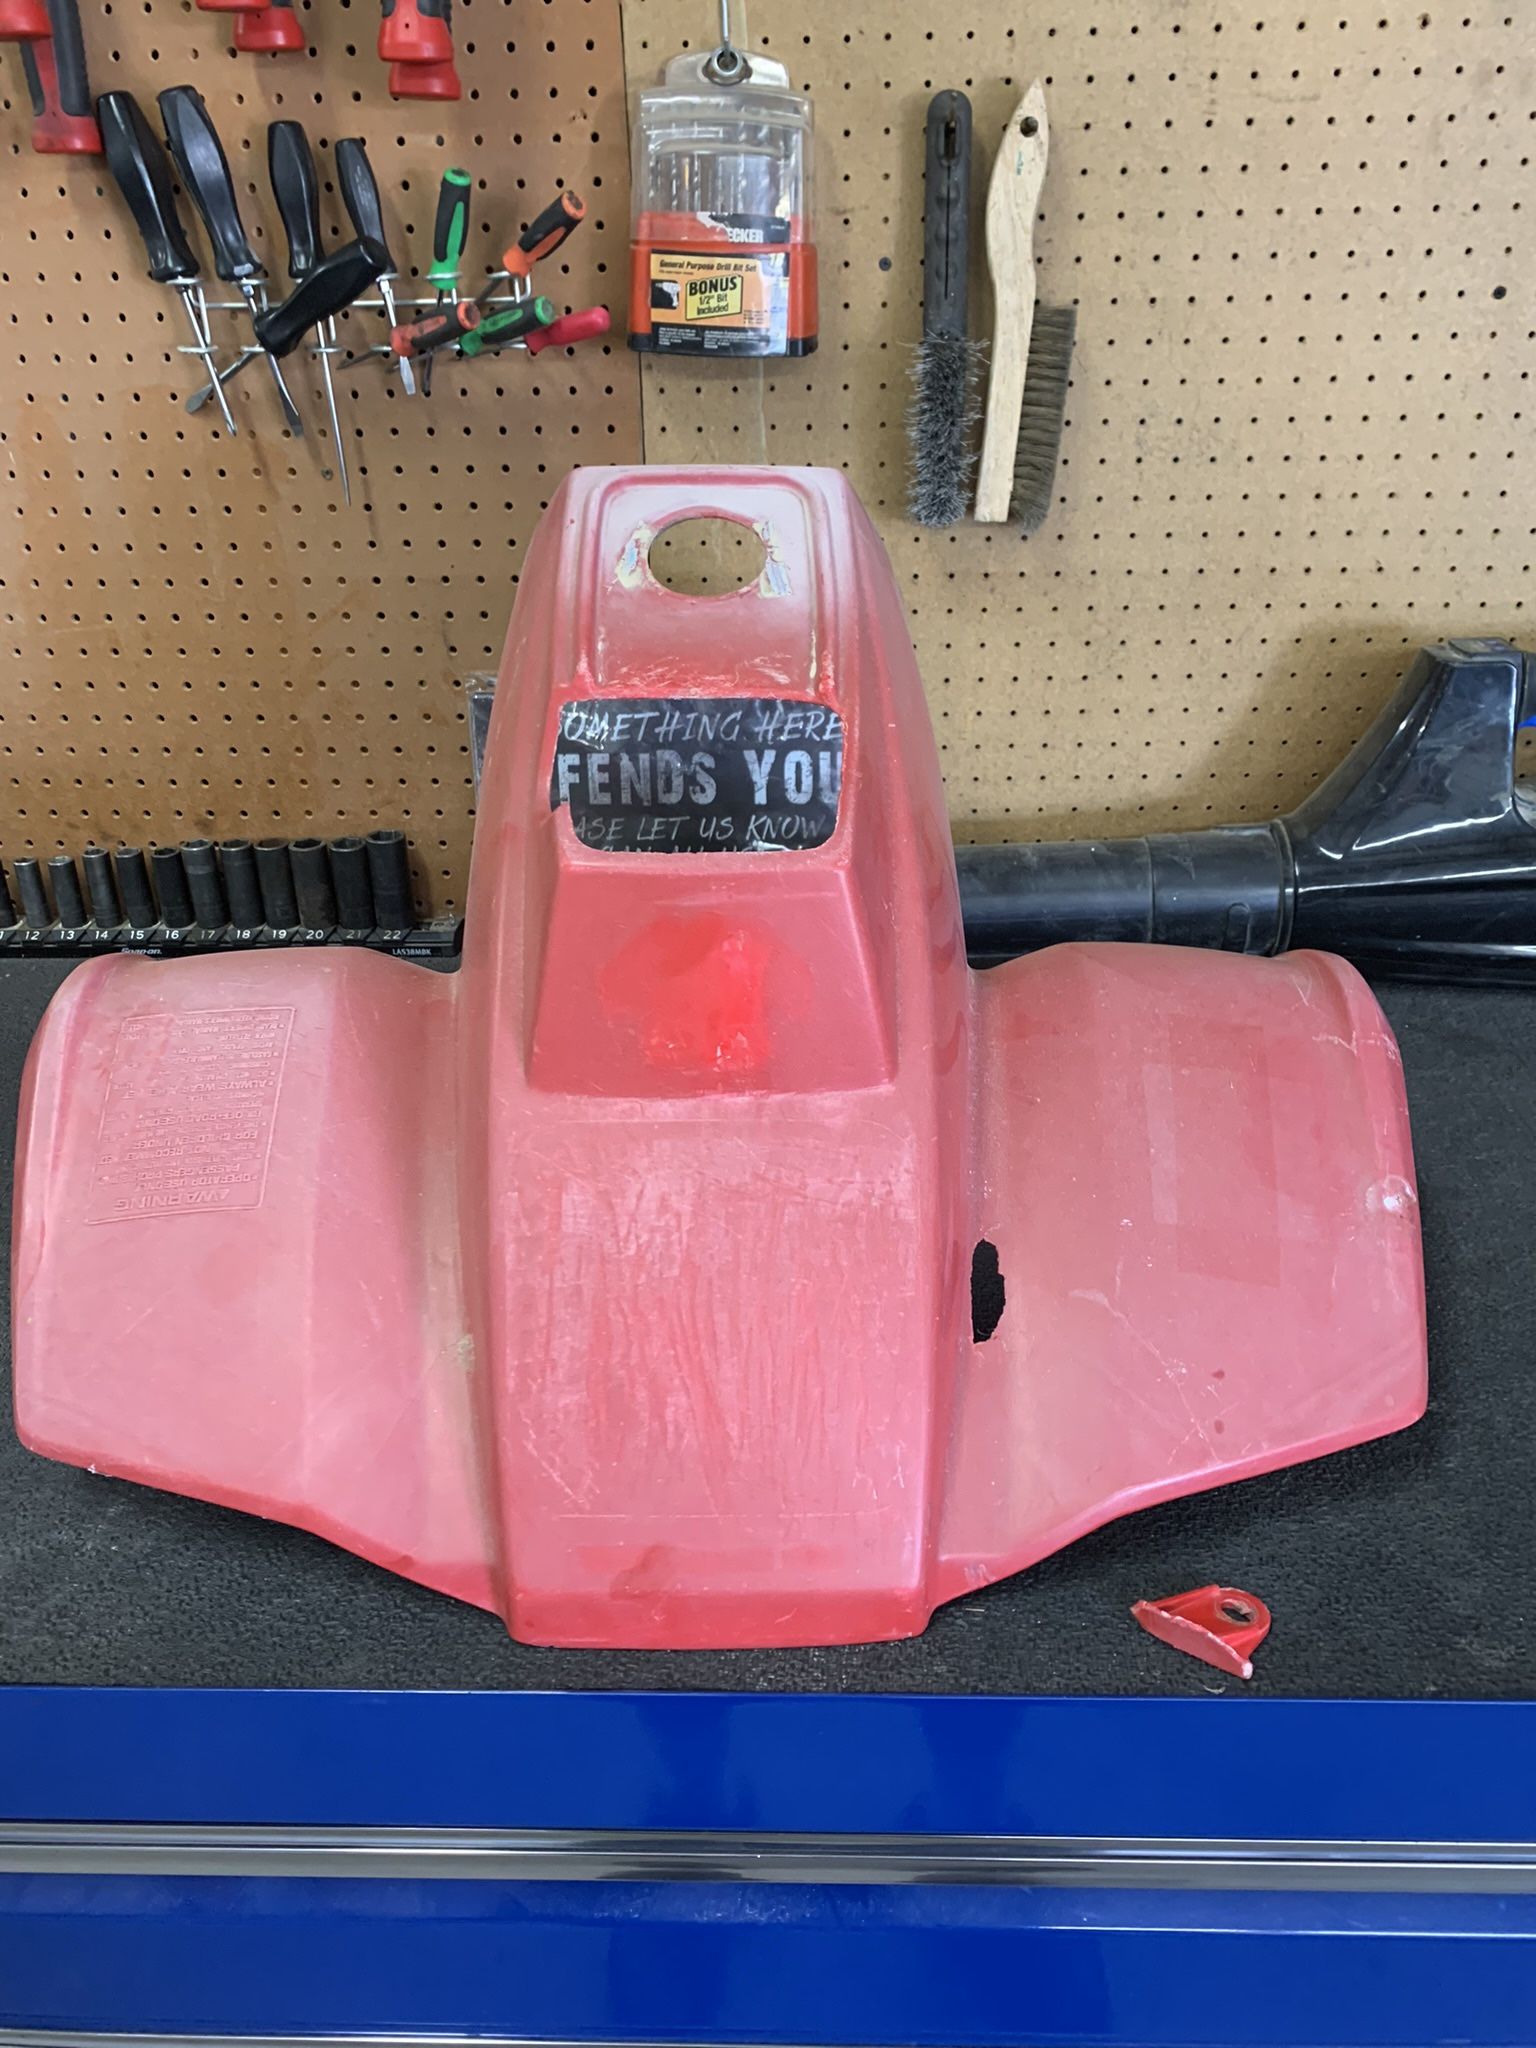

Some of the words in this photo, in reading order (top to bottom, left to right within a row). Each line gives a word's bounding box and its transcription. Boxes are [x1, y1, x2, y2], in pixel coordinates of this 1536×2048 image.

[660, 259, 685, 269] General
[686, 261, 715, 271] Purpose
[716, 262, 731, 271] Drill
[733, 263, 744, 272] Bit
[745, 264, 757, 272] Set
[689, 276, 737, 296] BONUS
[699, 295, 715, 305] 1/2"
[717, 293, 728, 303] Bit
[558, 710, 742, 742] OMETHING
[754, 710, 842, 744] HERE
[558, 749, 717, 806] FENDS
[743, 749, 842, 805] YOU
[636, 816, 690, 840] LET
[700, 816, 735, 841] US
[746, 814, 826, 841] KNOW
[25, 931, 40, 941] 12
[60, 930, 75, 940] 13
[95, 930, 109, 940] 14
[130, 930, 145, 940] 15
[165, 930, 180, 940] 16
[200, 930, 216, 940] 17
[236, 929, 251, 939] 18
[272, 929, 287, 939] 19
[306, 930, 324, 940] 20
[346, 930, 362, 940] 21
[383, 930, 401, 940] 22
[113, 1189, 218, 1212] WARNING
